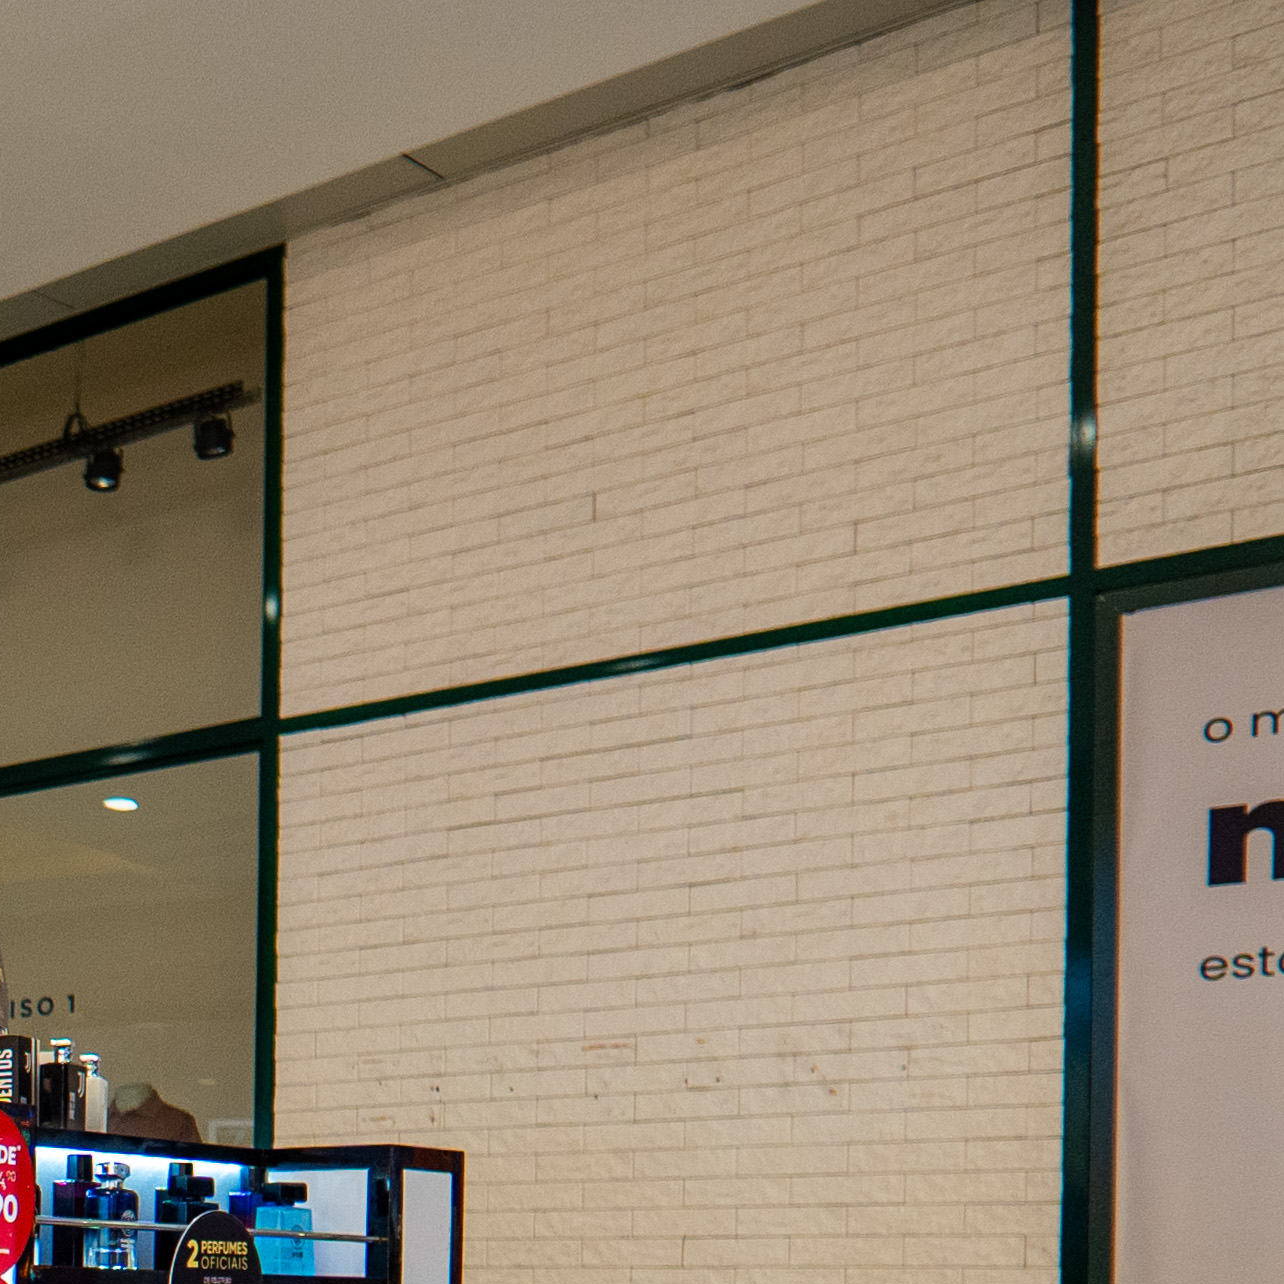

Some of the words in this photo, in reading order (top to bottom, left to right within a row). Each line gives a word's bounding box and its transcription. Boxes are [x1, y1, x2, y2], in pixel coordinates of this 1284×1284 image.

[1204, 716, 1233, 743] o
[10, 997, 54, 1019] ISO
[67, 994, 75, 1013] 1
[187, 1239, 199, 1269] 2
[201, 1240, 248, 1255] PERFUMES
[201, 1256, 248, 1271] OFICIAIS
